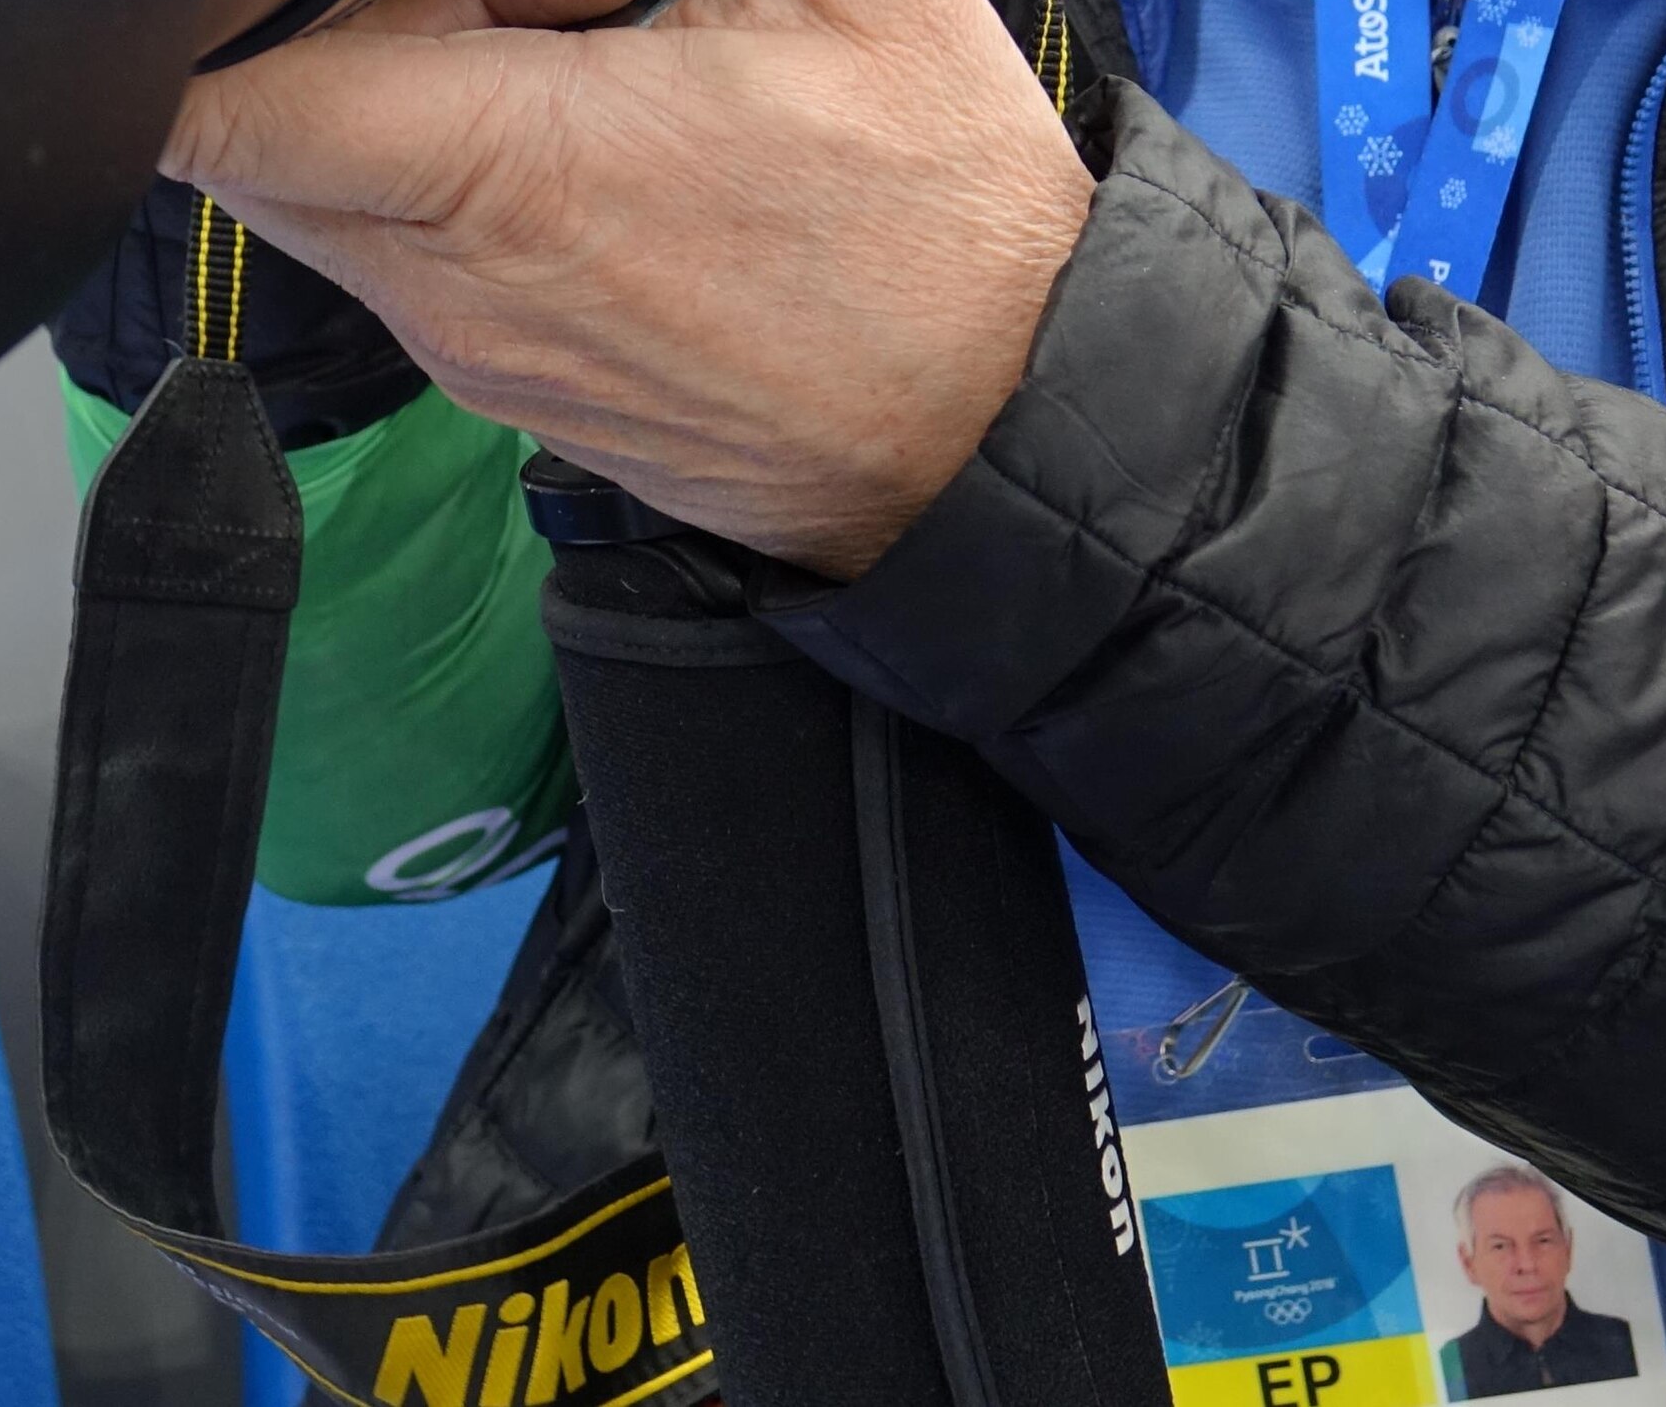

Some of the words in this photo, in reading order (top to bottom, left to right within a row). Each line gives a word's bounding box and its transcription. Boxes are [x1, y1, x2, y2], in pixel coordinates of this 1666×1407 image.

[1428, 259, 1452, 286] P
[1077, 993, 1135, 1256] Nikon
[373, 1242, 706, 1407] Nikon
[1258, 1355, 1340, 1407] EP
